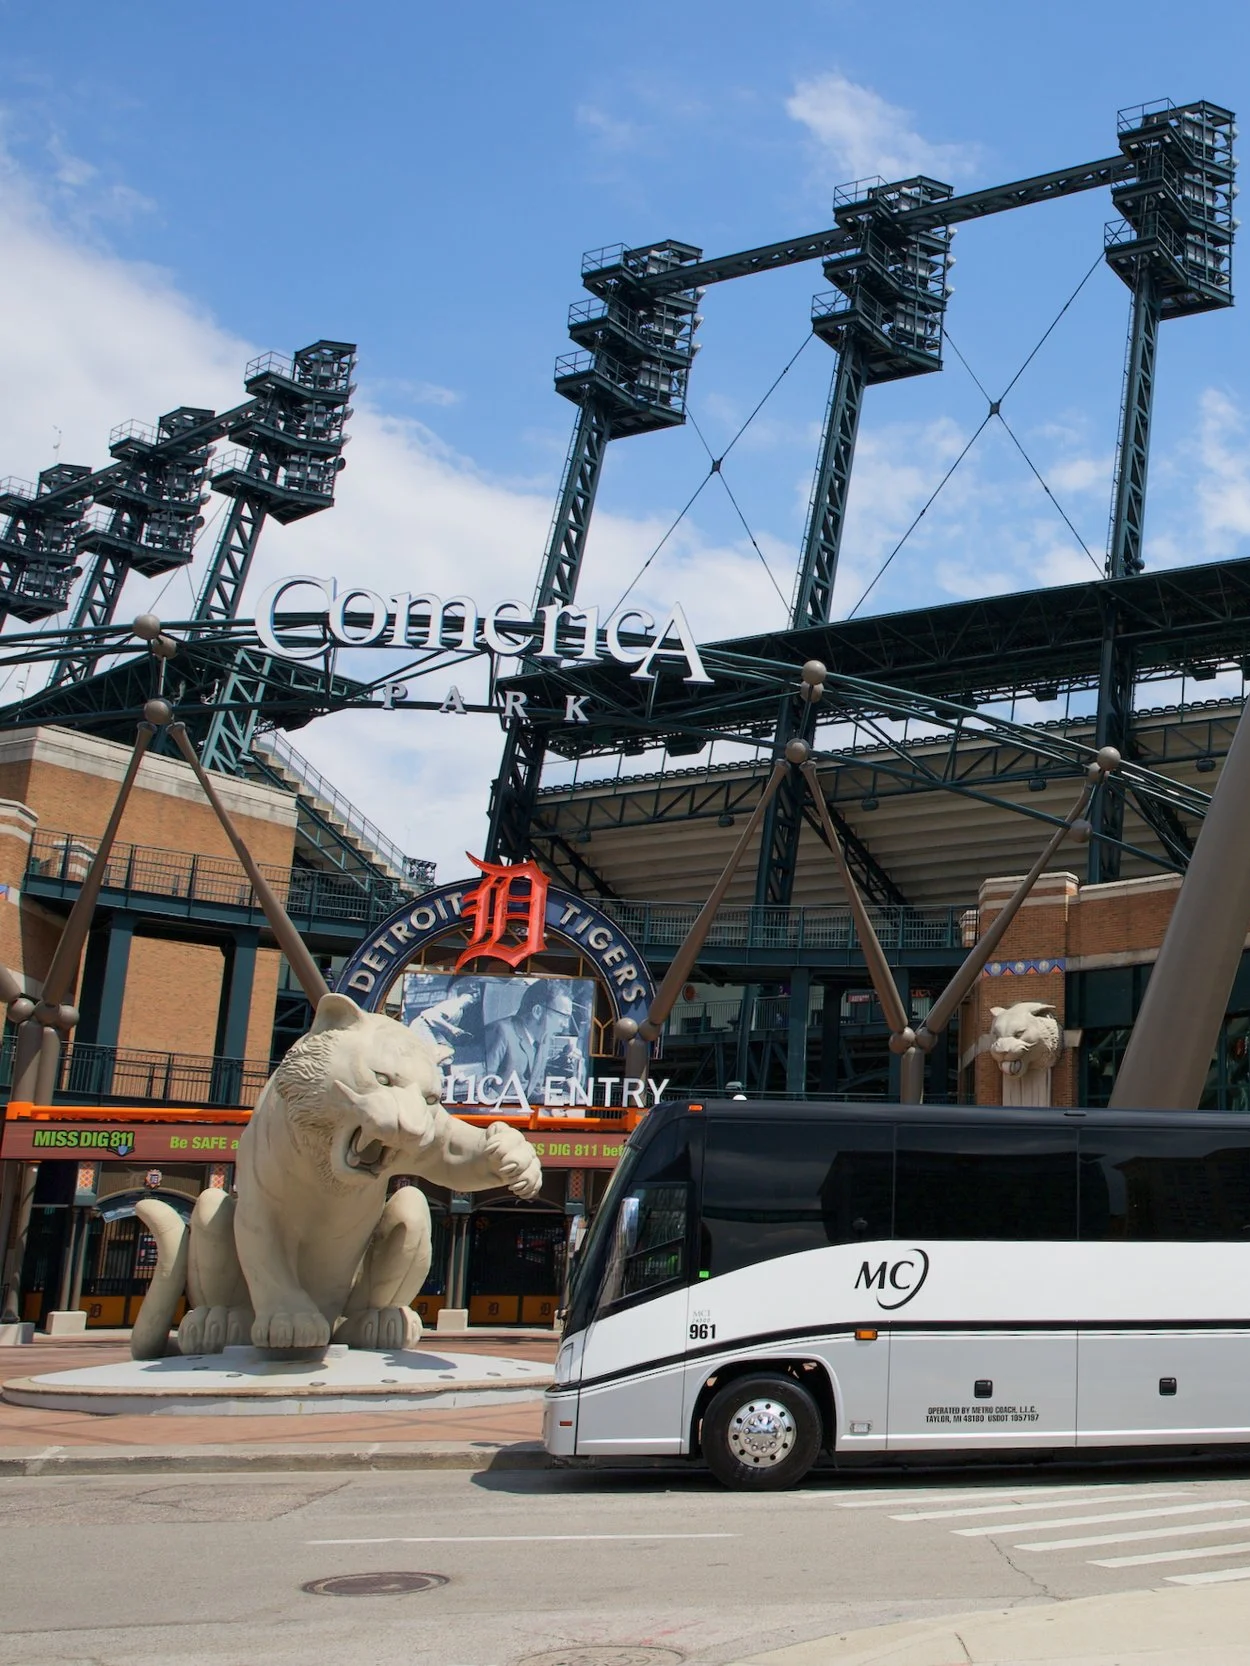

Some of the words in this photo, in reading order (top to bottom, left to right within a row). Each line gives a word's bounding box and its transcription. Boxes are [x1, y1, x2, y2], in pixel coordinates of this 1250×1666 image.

[382, 682, 591, 724] PARK
[349, 892, 464, 994] DETROIT
[557, 901, 647, 1003] TIGERS
[544, 1076, 669, 1108] ENTRY
[34, 1130, 79, 1147] MISS
[80, 1132, 109, 1147] DIG
[109, 1131, 135, 1147] 811
[170, 1136, 187, 1149] Be
[192, 1136, 227, 1149] SAFE
[549, 1143, 571, 1156] DIG
[575, 1144, 598, 1157] 811
[854, 1261, 917, 1290] MC
[689, 1323, 717, 1340] 961
[926, 1415, 952, 1423] TAYLOR,
[953, 1415, 962, 1423] MI
[987, 1414, 1009, 1422] USDOT
[927, 1406, 960, 1414] OPERATED
[961, 1406, 970, 1414] BY
[971, 1406, 994, 1414] METRO
